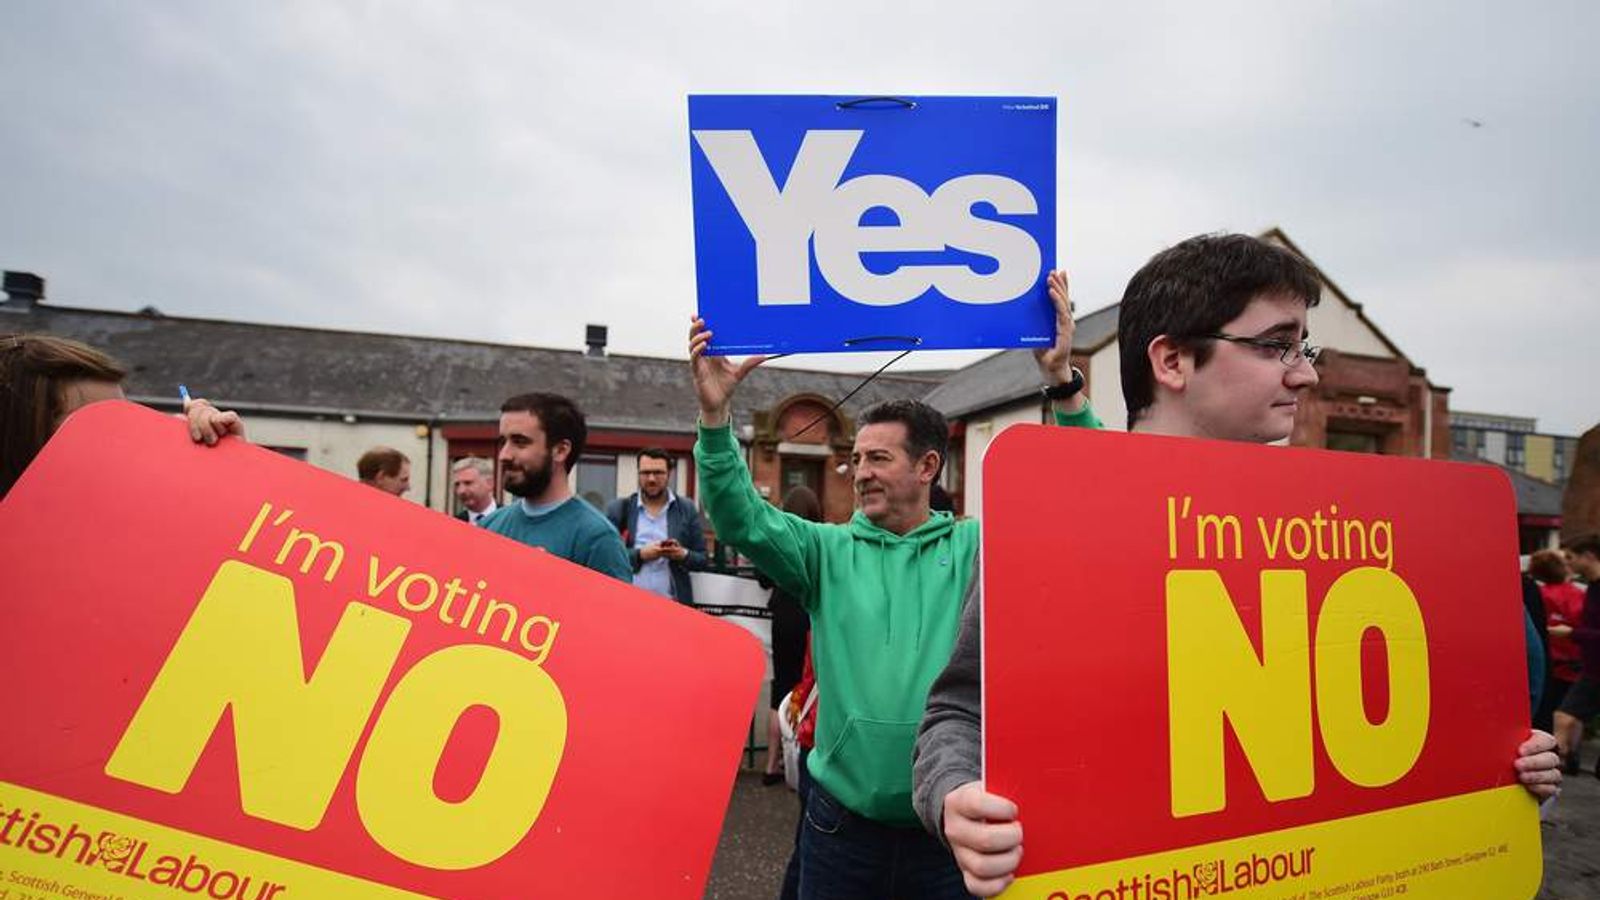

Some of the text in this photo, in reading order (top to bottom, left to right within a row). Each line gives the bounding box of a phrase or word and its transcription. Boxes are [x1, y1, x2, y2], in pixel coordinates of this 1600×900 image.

[691, 129, 1042, 306] Yes
[238, 501, 561, 665] I'm voting
[1167, 496, 1394, 571] I'm voting
[105, 559, 568, 871] NO
[1165, 567, 1431, 819] NO
[0, 804, 286, 900] tish Labour
[8, 869, 60, 894] Scottish
[1219, 846, 1316, 894] Labour
